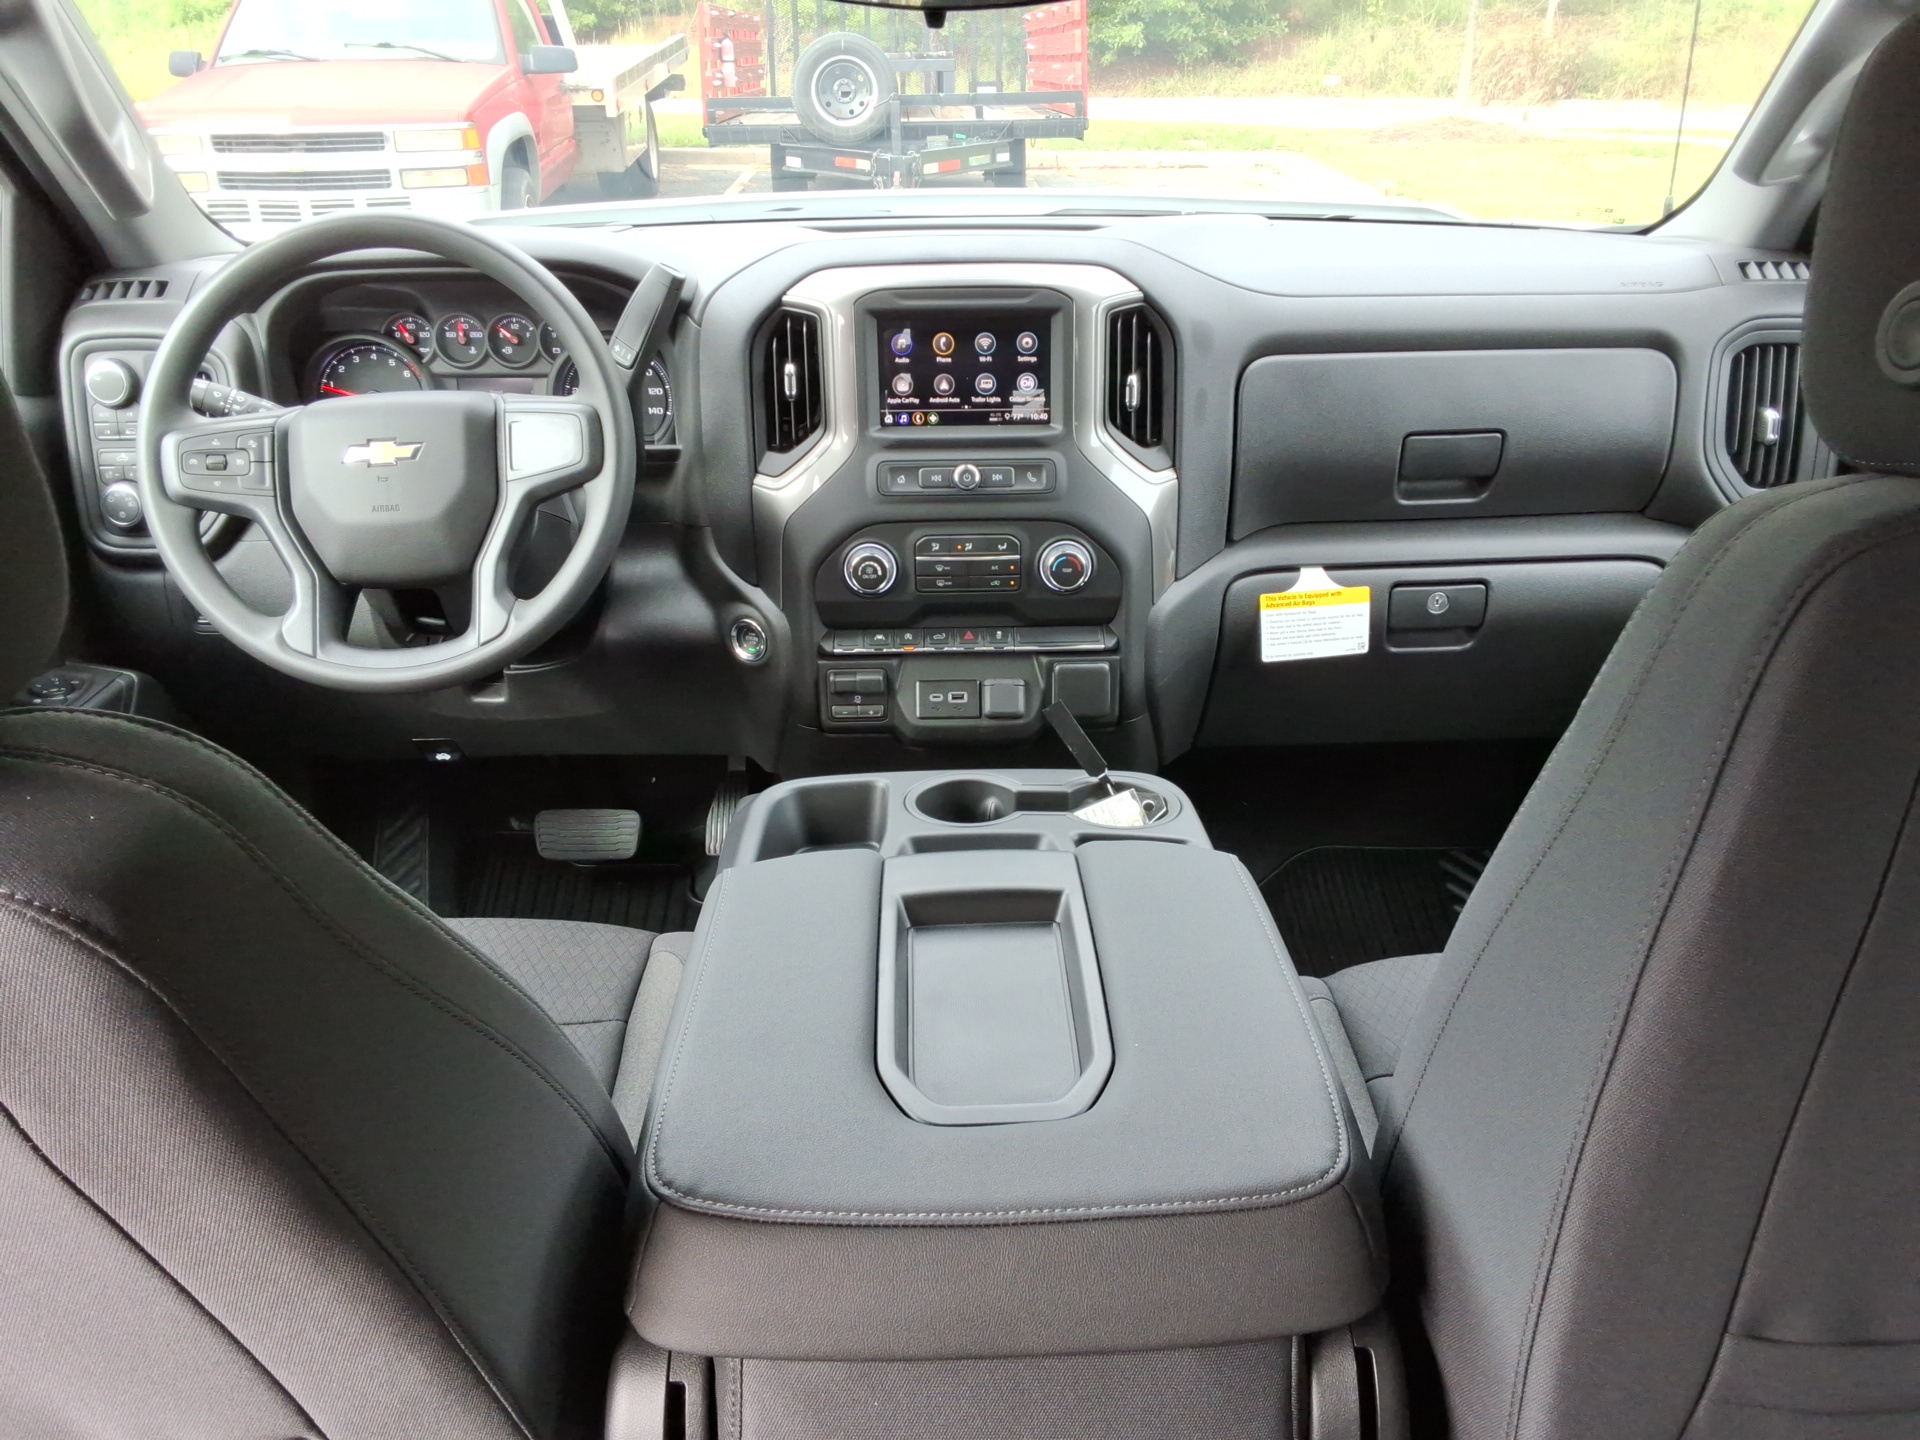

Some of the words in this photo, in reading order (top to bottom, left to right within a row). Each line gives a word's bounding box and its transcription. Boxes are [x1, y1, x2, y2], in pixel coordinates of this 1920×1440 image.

[370, 353, 377, 361] 4
[388, 359, 396, 367] 5
[338, 365, 345, 373] 2
[403, 370, 411, 378] 6
[648, 387, 663, 395] 120
[648, 406, 664, 415] 140
[1030, 412, 1049, 420] 10:40
[371, 504, 400, 513] AIRBAG
[1304, 592, 1329, 600] Equipped
